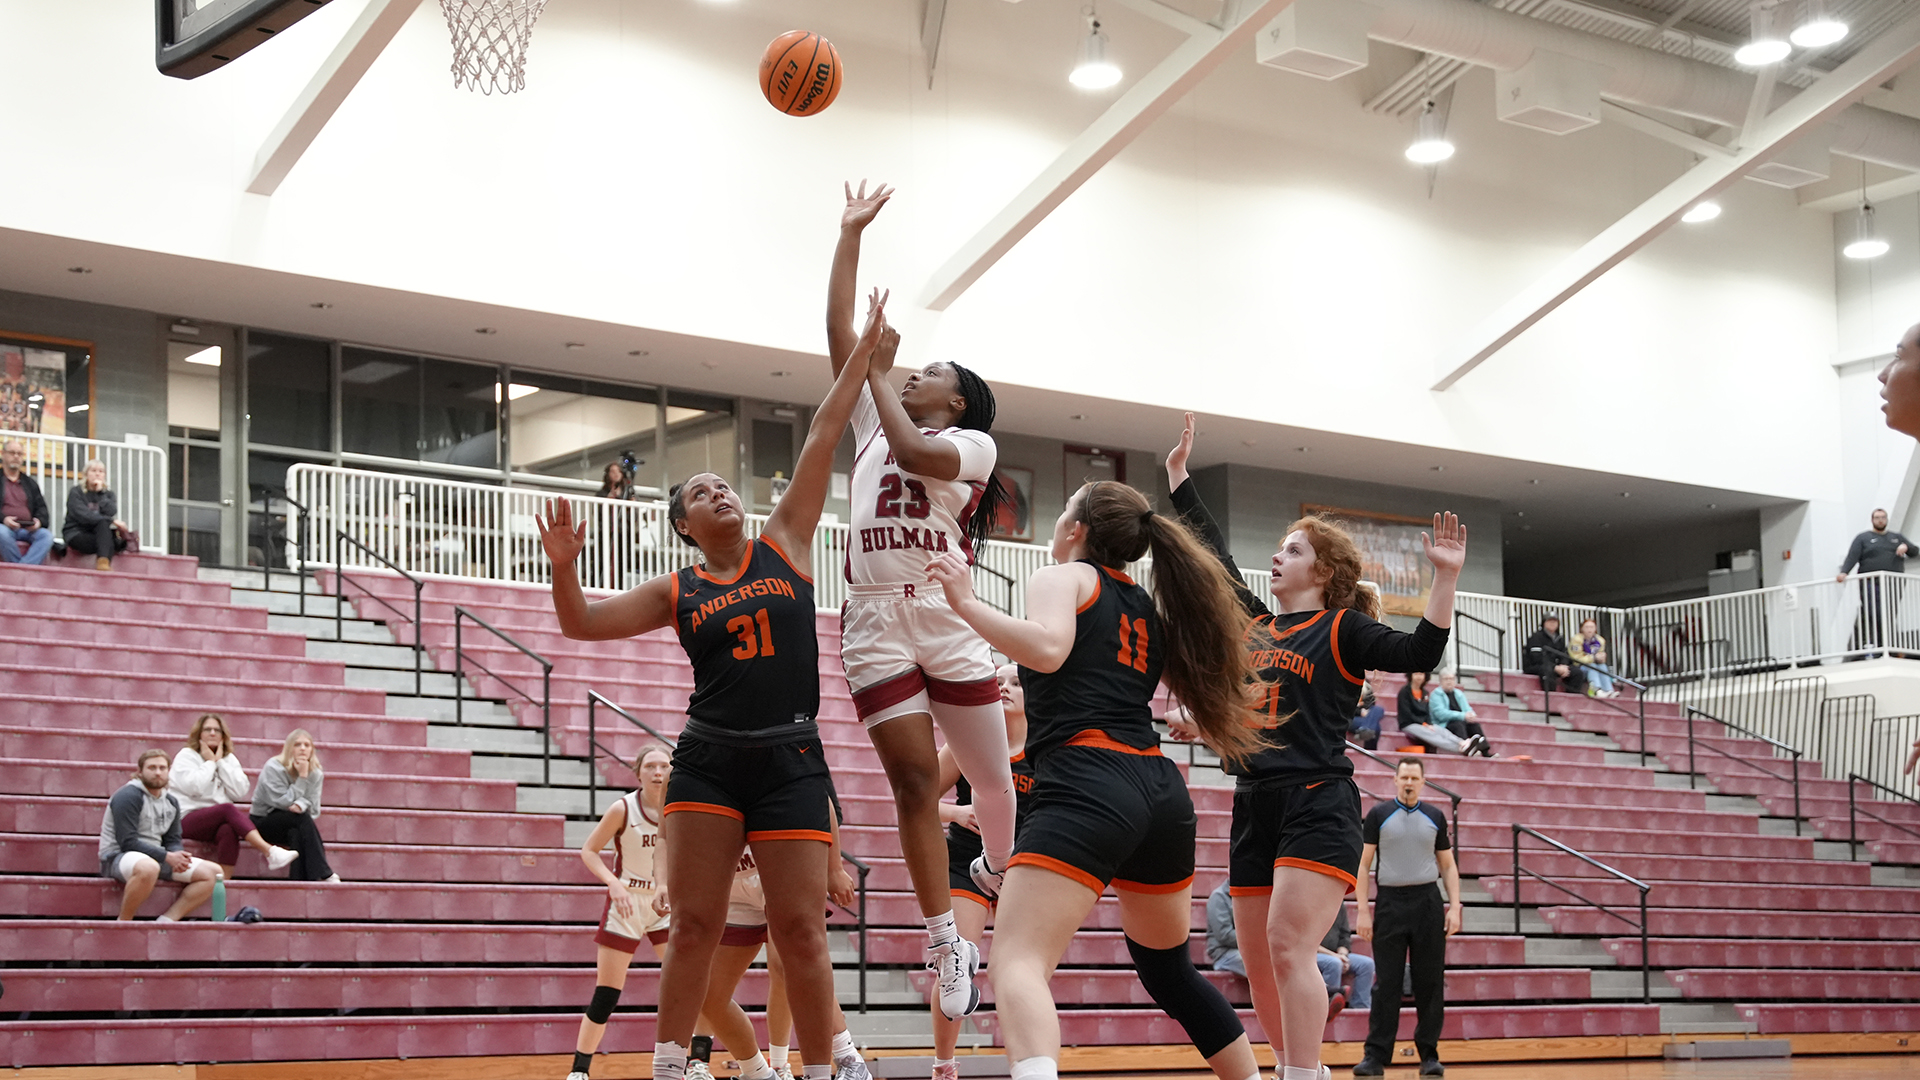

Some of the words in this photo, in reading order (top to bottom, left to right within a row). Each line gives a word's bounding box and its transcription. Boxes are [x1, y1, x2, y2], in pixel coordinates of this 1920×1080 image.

[795, 62, 831, 112] Wilson
[874, 472, 932, 520] 23
[859, 526, 949, 553] HULMAN
[691, 577, 796, 633] ANDERSON
[903, 583, 916, 598] R
[725, 607, 775, 661] 31
[1117, 612, 1150, 674] 11
[1249, 649, 1315, 684] DERSON
